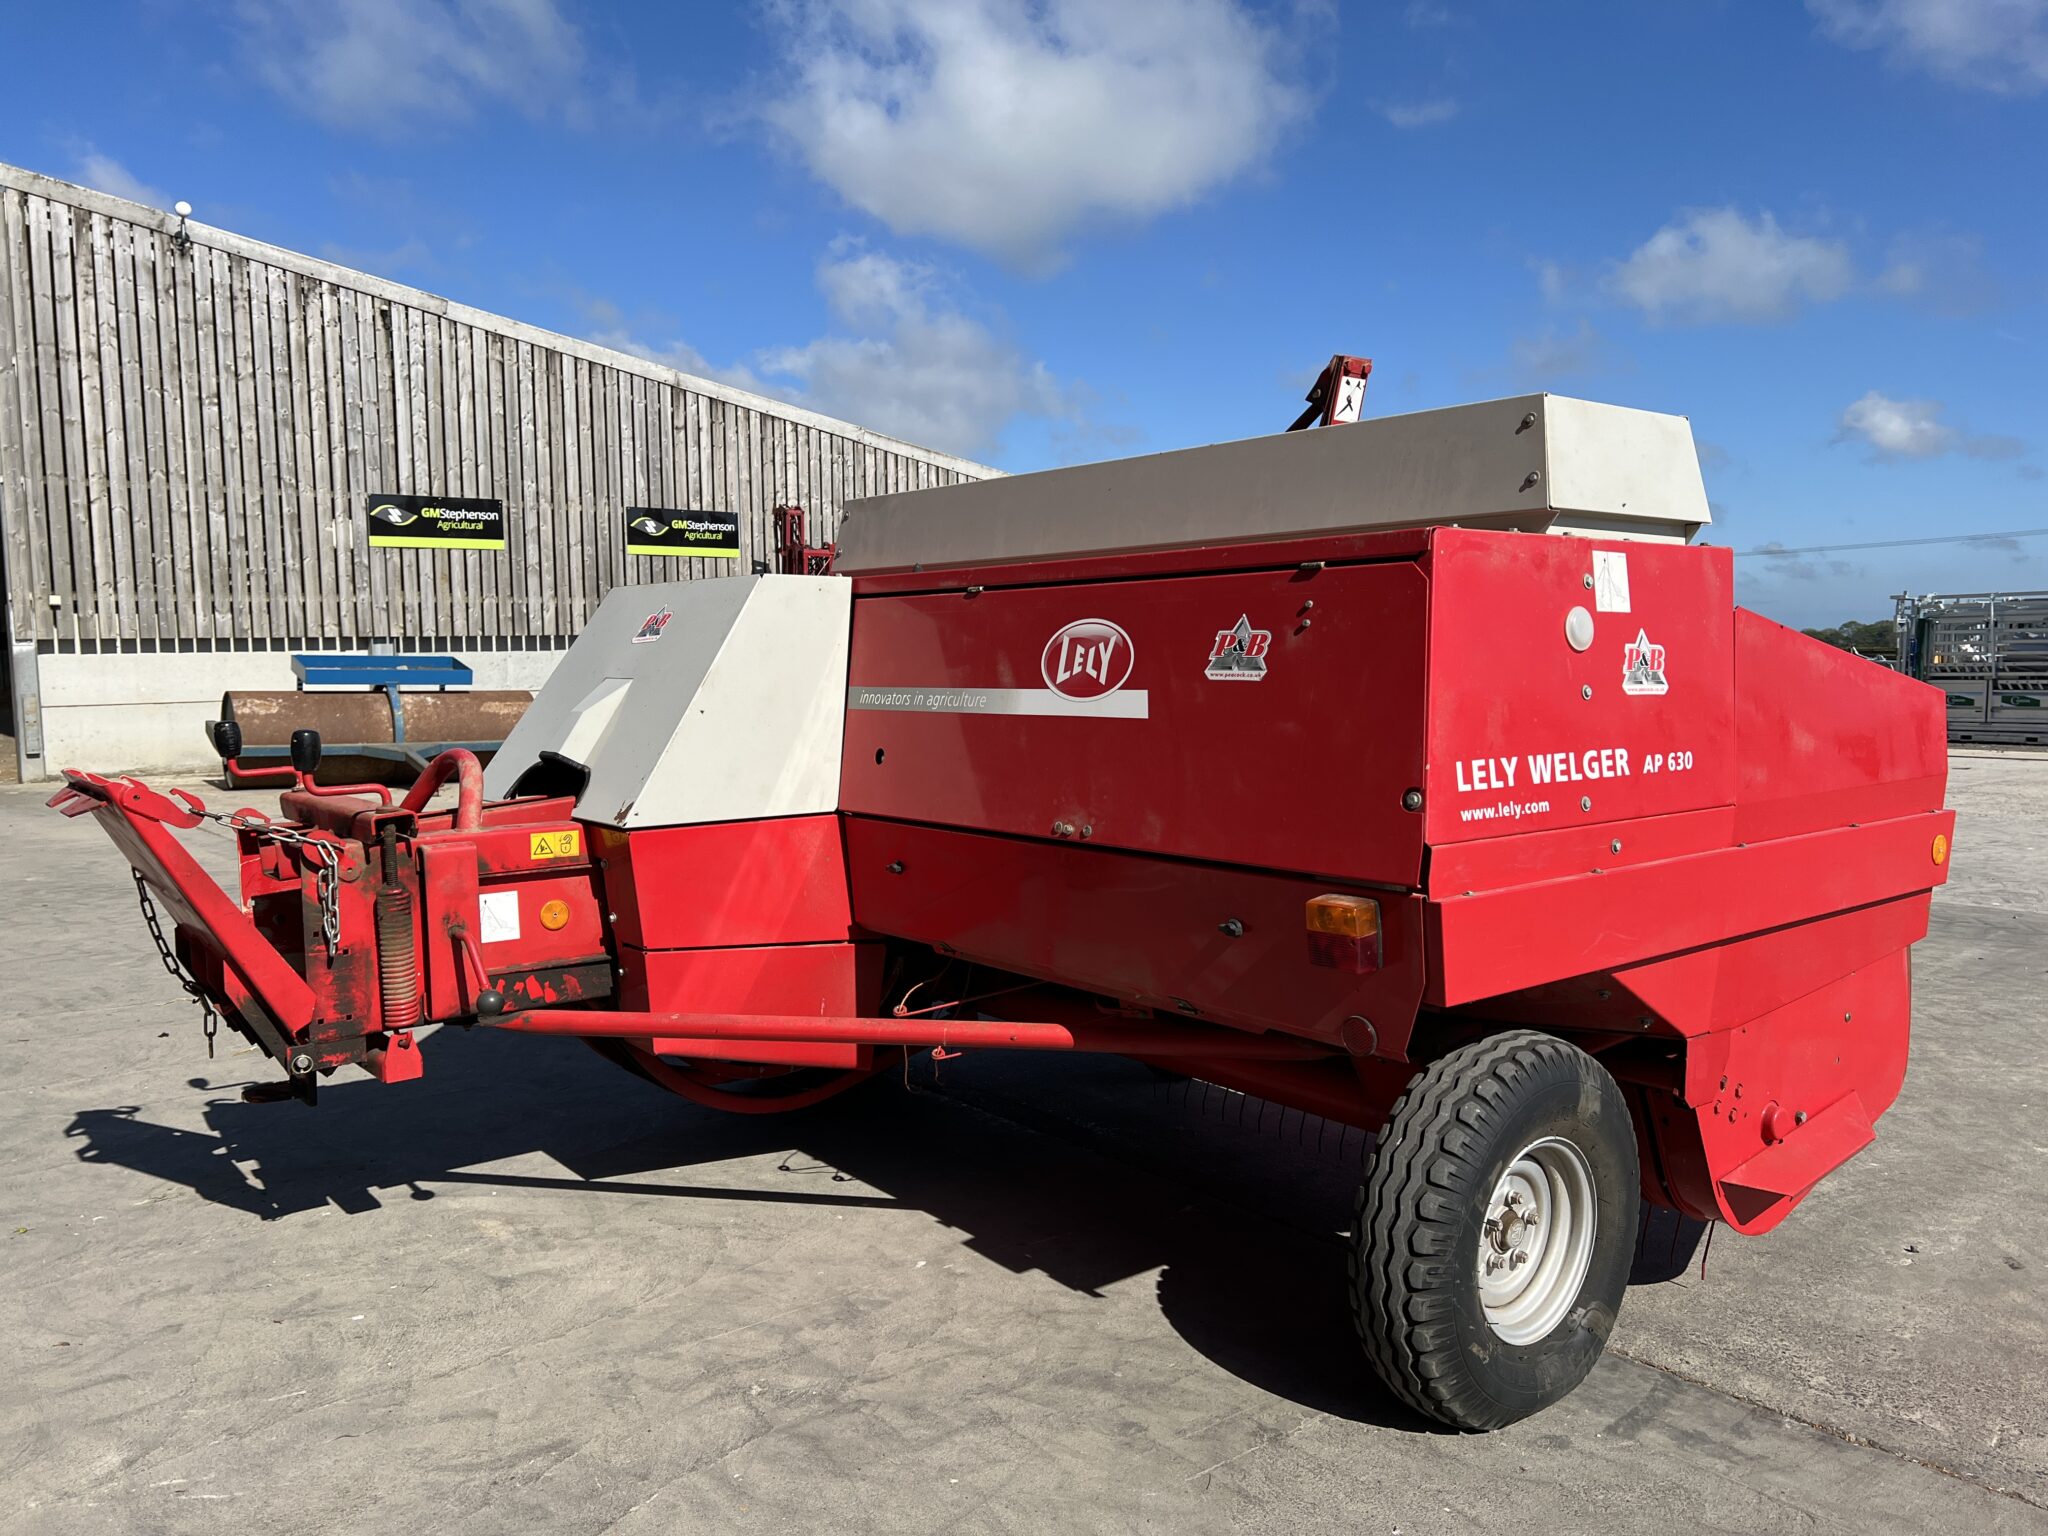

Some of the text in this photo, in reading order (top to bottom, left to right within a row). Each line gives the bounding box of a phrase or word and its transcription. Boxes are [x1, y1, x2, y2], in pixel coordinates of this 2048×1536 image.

[421, 507, 499, 521] GMStephenson
[437, 520, 484, 532] Agricultural
[671, 519, 735, 532] GMStephenson
[684, 531, 723, 541] Agricultural
[1055, 634, 1118, 687] LELY
[859, 689, 988, 710] innovators in agriculture
[1455, 748, 1694, 793] LELY WELGER AP 630
[1460, 800, 1551, 823] www.lely.com
